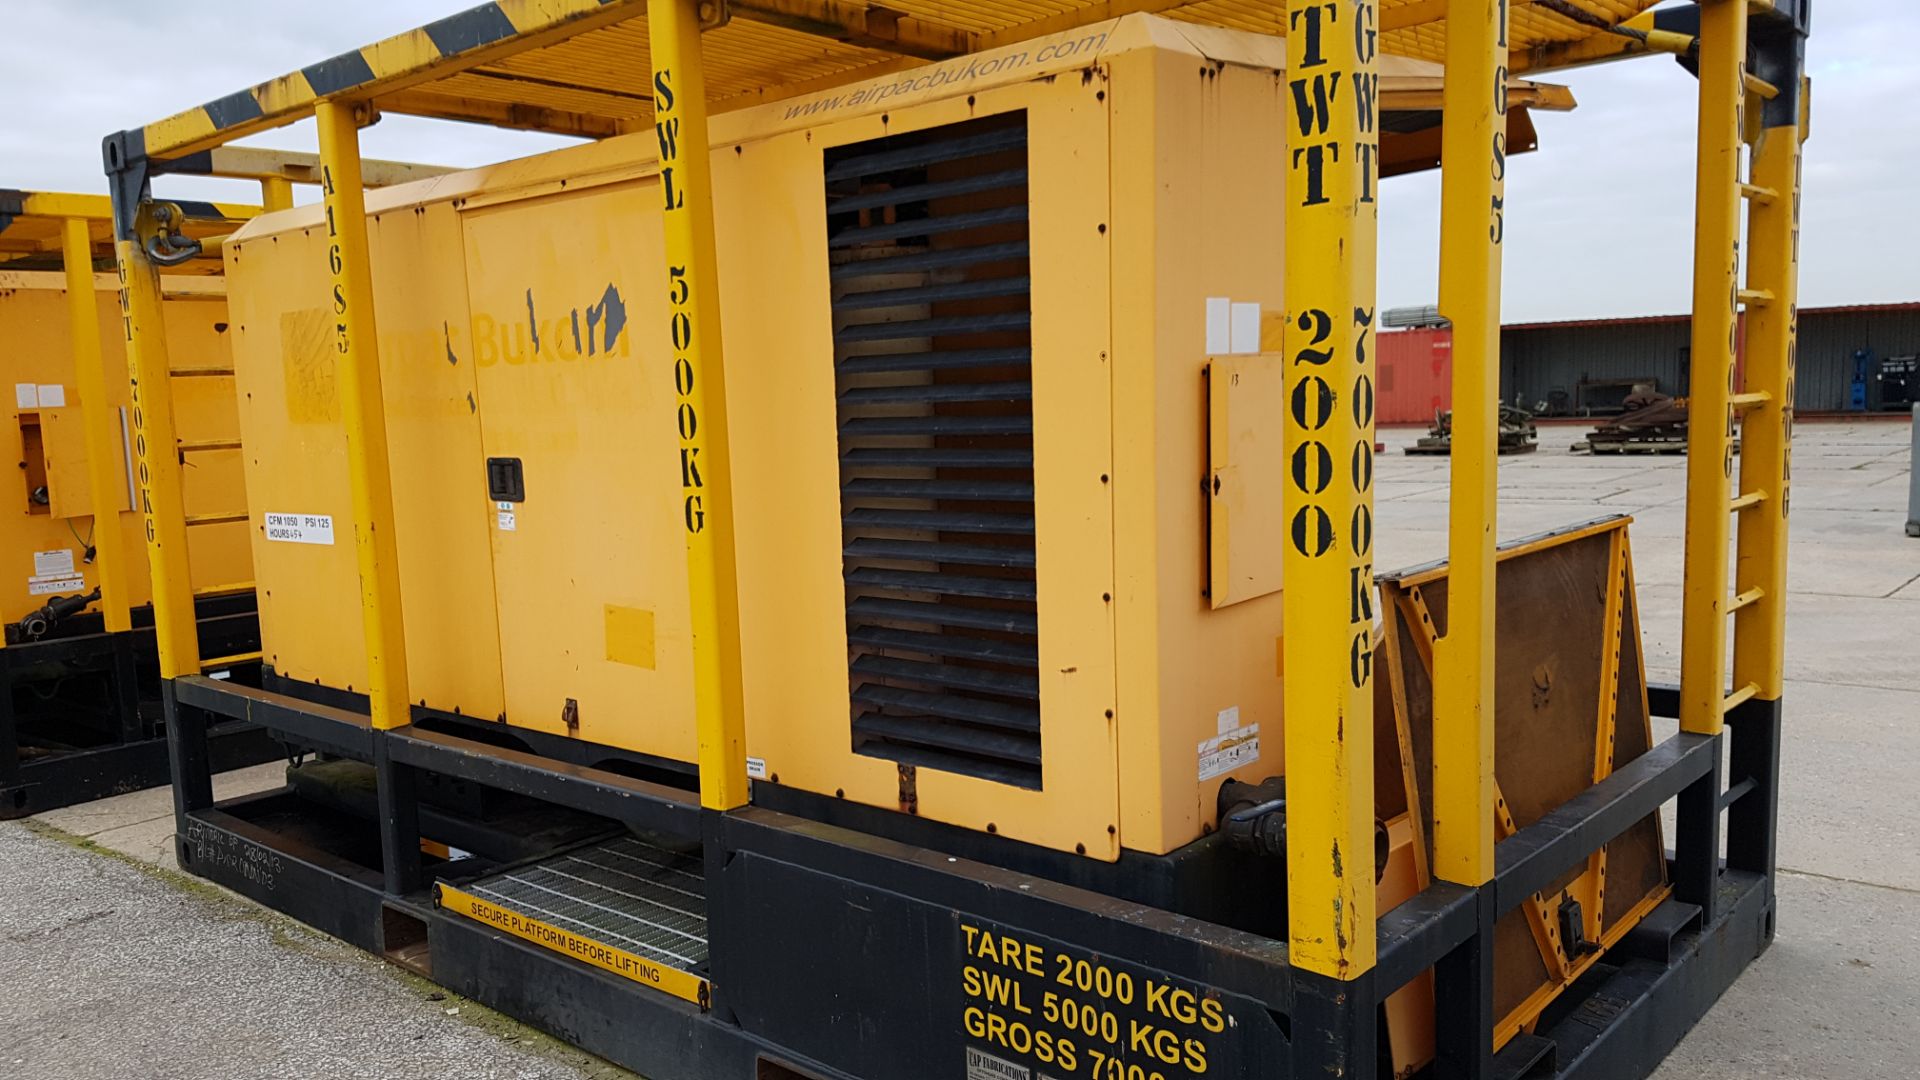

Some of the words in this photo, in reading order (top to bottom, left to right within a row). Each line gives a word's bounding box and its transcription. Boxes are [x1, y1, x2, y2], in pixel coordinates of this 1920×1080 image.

[784, 32, 1107, 121] www.airpacbukom.com
[1289, 3, 1341, 207] TWT
[1352, 3, 1378, 203] GWT
[654, 70, 683, 211] SWL
[669, 265, 705, 534] 5000KG
[1290, 308, 1334, 558] 2000
[268, 515, 283, 526] CFM
[283, 516, 298, 527] 1050
[305, 517, 317, 529] PSI
[317, 518, 330, 529] 125
[269, 528, 290, 539] HOURS
[1350, 306, 1374, 688] 7000KG
[471, 901, 510, 927] SECURE
[511, 917, 567, 947] PLATFORM
[568, 938, 613, 966] BEFORE
[615, 954, 661, 983] LIFTING
[960, 924, 1045, 977] TARE
[1056, 954, 1134, 1005] 2000
[1146, 980, 1225, 1033] KGS
[963, 966, 1032, 1014] SWL
[1043, 992, 1119, 1044] 5000
[1131, 1020, 1208, 1073] KGS
[964, 1007, 1078, 1072] GROSS
[1088, 1049, 1166, 1080] 700
